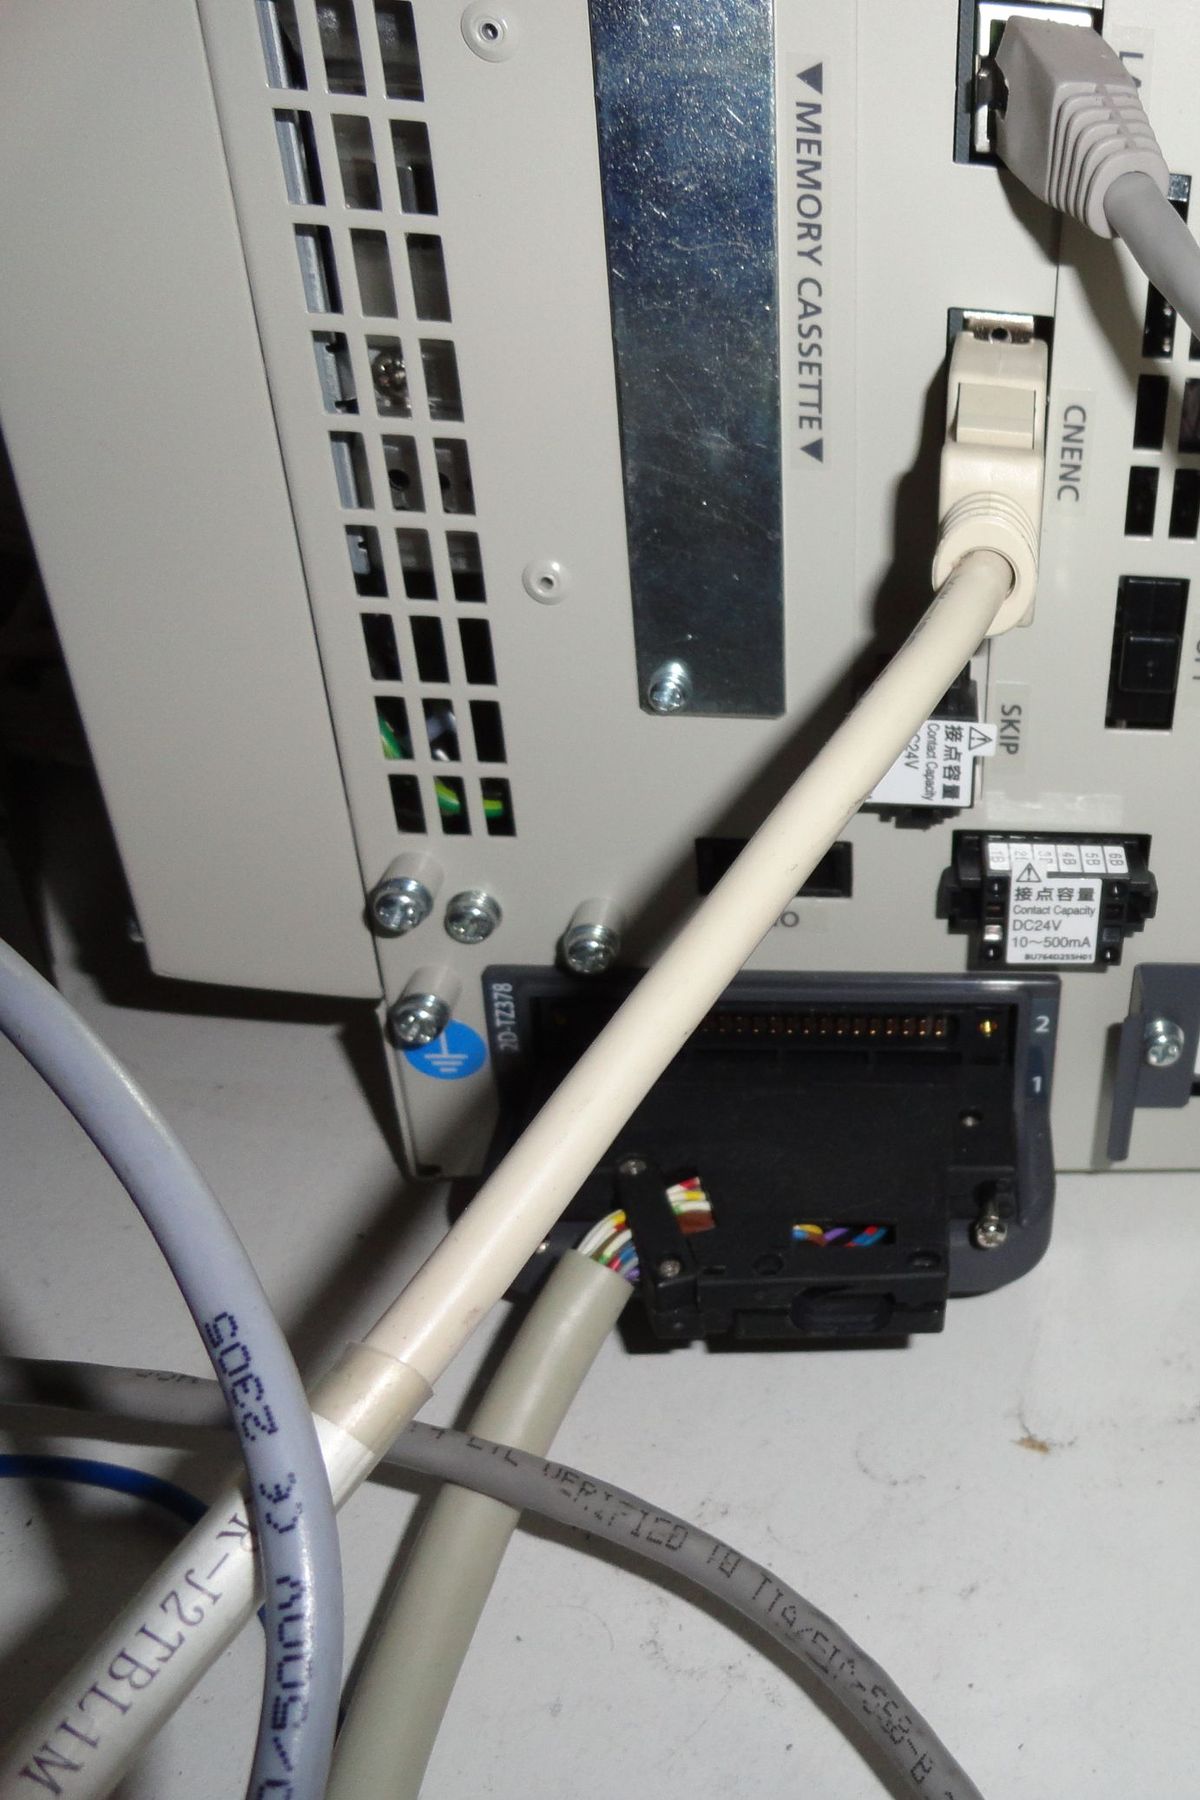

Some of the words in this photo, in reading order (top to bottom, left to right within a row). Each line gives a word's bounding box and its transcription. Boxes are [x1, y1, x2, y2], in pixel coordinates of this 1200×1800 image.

[795, 101, 823, 266] MEMORY
[796, 277, 823, 431] CASSETTE
[1057, 404, 1087, 502] CNENC
[925, 722, 941, 759] Contact
[999, 704, 1023, 755] SKIP
[921, 761, 938, 801] Capacity
[941, 724, 963, 800] 接点容量
[1062, 852, 1077, 865] 4B
[1085, 852, 1101, 866] 5B
[1109, 853, 1125, 866] 6B
[1013, 904, 1050, 916] Contact
[1053, 904, 1096, 918] Capacity
[1014, 886, 1096, 902] 接点容量
[1012, 919, 1063, 932] DC24V
[491, 982, 520, 1051] 2D-TZ378
[1034, 1014, 1051, 1033] 2
[1032, 1075, 1043, 1094] 1
[203, 1311, 279, 1442] 2305
[18, 1510, 258, 1798] R-J2TBL1M
